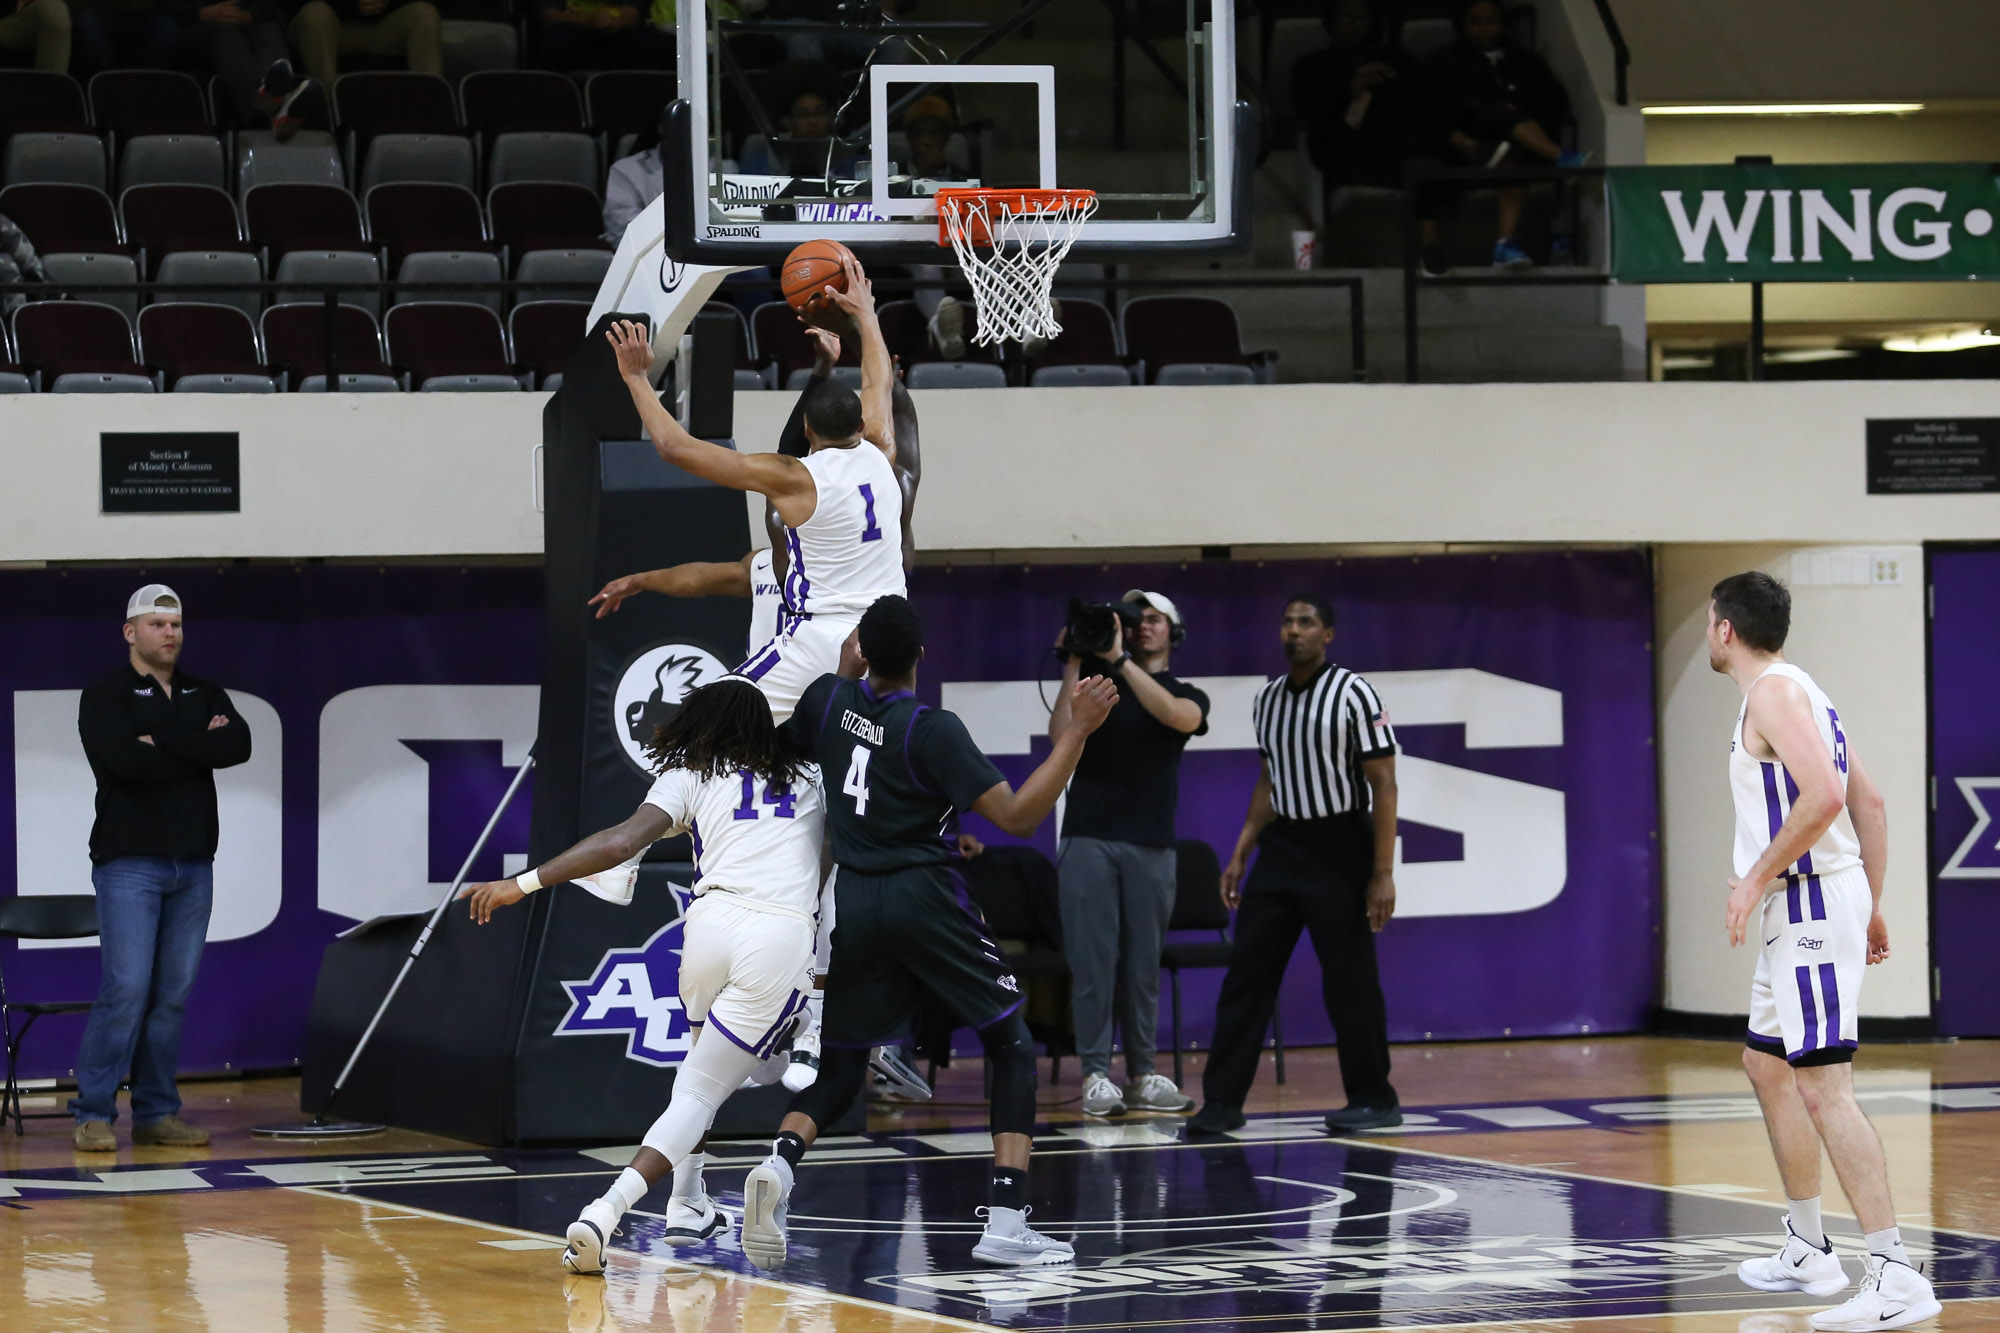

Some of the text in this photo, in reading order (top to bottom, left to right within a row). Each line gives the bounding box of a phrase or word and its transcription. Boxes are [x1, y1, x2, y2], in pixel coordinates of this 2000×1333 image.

[707, 226, 761, 239] SPALDING
[1661, 187, 1952, 262] WING
[128, 462, 212, 473] of Moody Coliseum
[150, 450, 191, 460] Section F
[858, 483, 882, 542] 1
[841, 709, 885, 746] FITZGERALD
[734, 768, 796, 820] 14
[843, 745, 871, 816] 4
[1797, 936, 1823, 950] ACU
